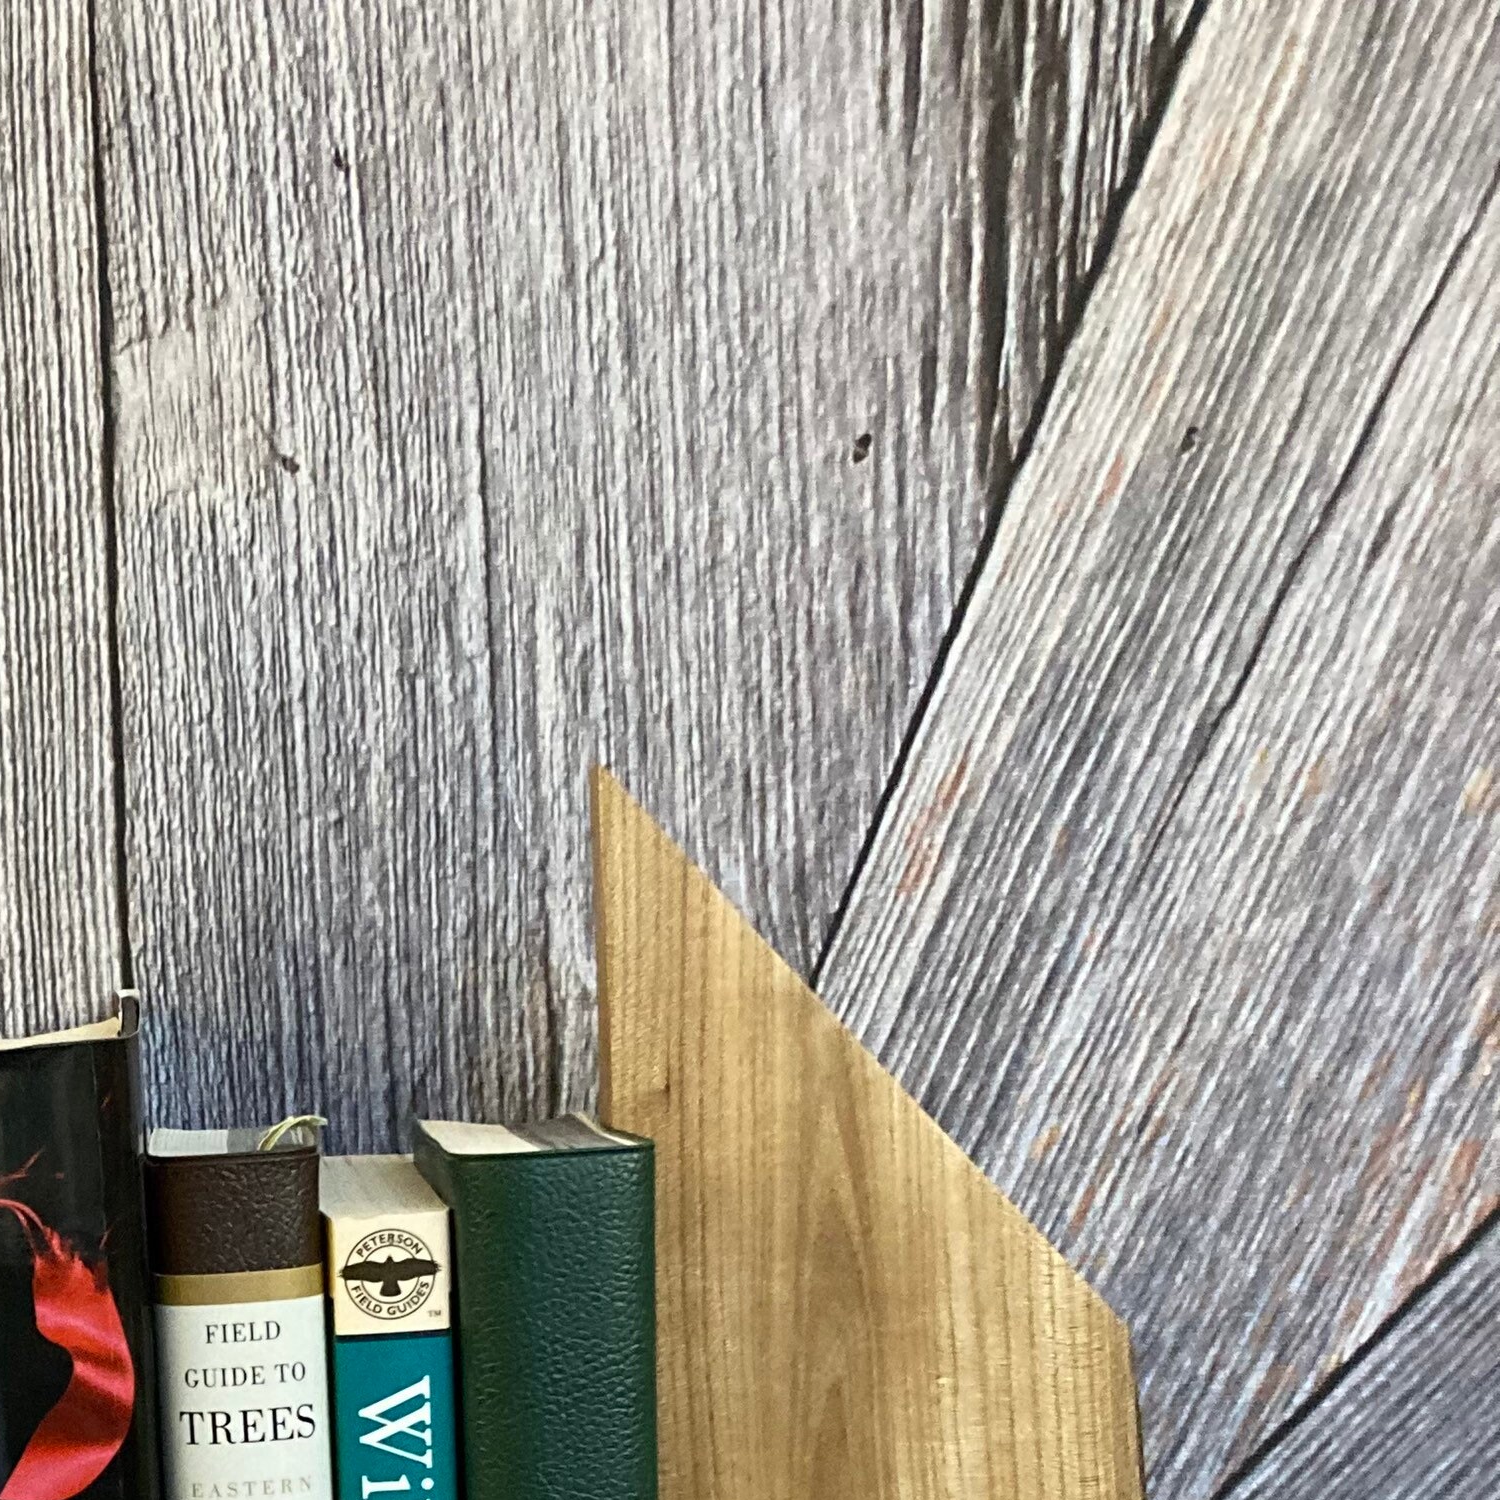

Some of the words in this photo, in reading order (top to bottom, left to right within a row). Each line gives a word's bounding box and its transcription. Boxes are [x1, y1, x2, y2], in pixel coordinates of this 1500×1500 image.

[356, 1233, 423, 1257] PETERSON
[351, 1285, 382, 1314] FIELD
[387, 1281, 429, 1315] GUIDES
[205, 1320, 281, 1344] FIELD
[184, 1366, 265, 1388] GUIDE
[274, 1362, 306, 1383] TO
[179, 1404, 316, 1445] TREES
[191, 1475, 312, 1499] EASTERN
